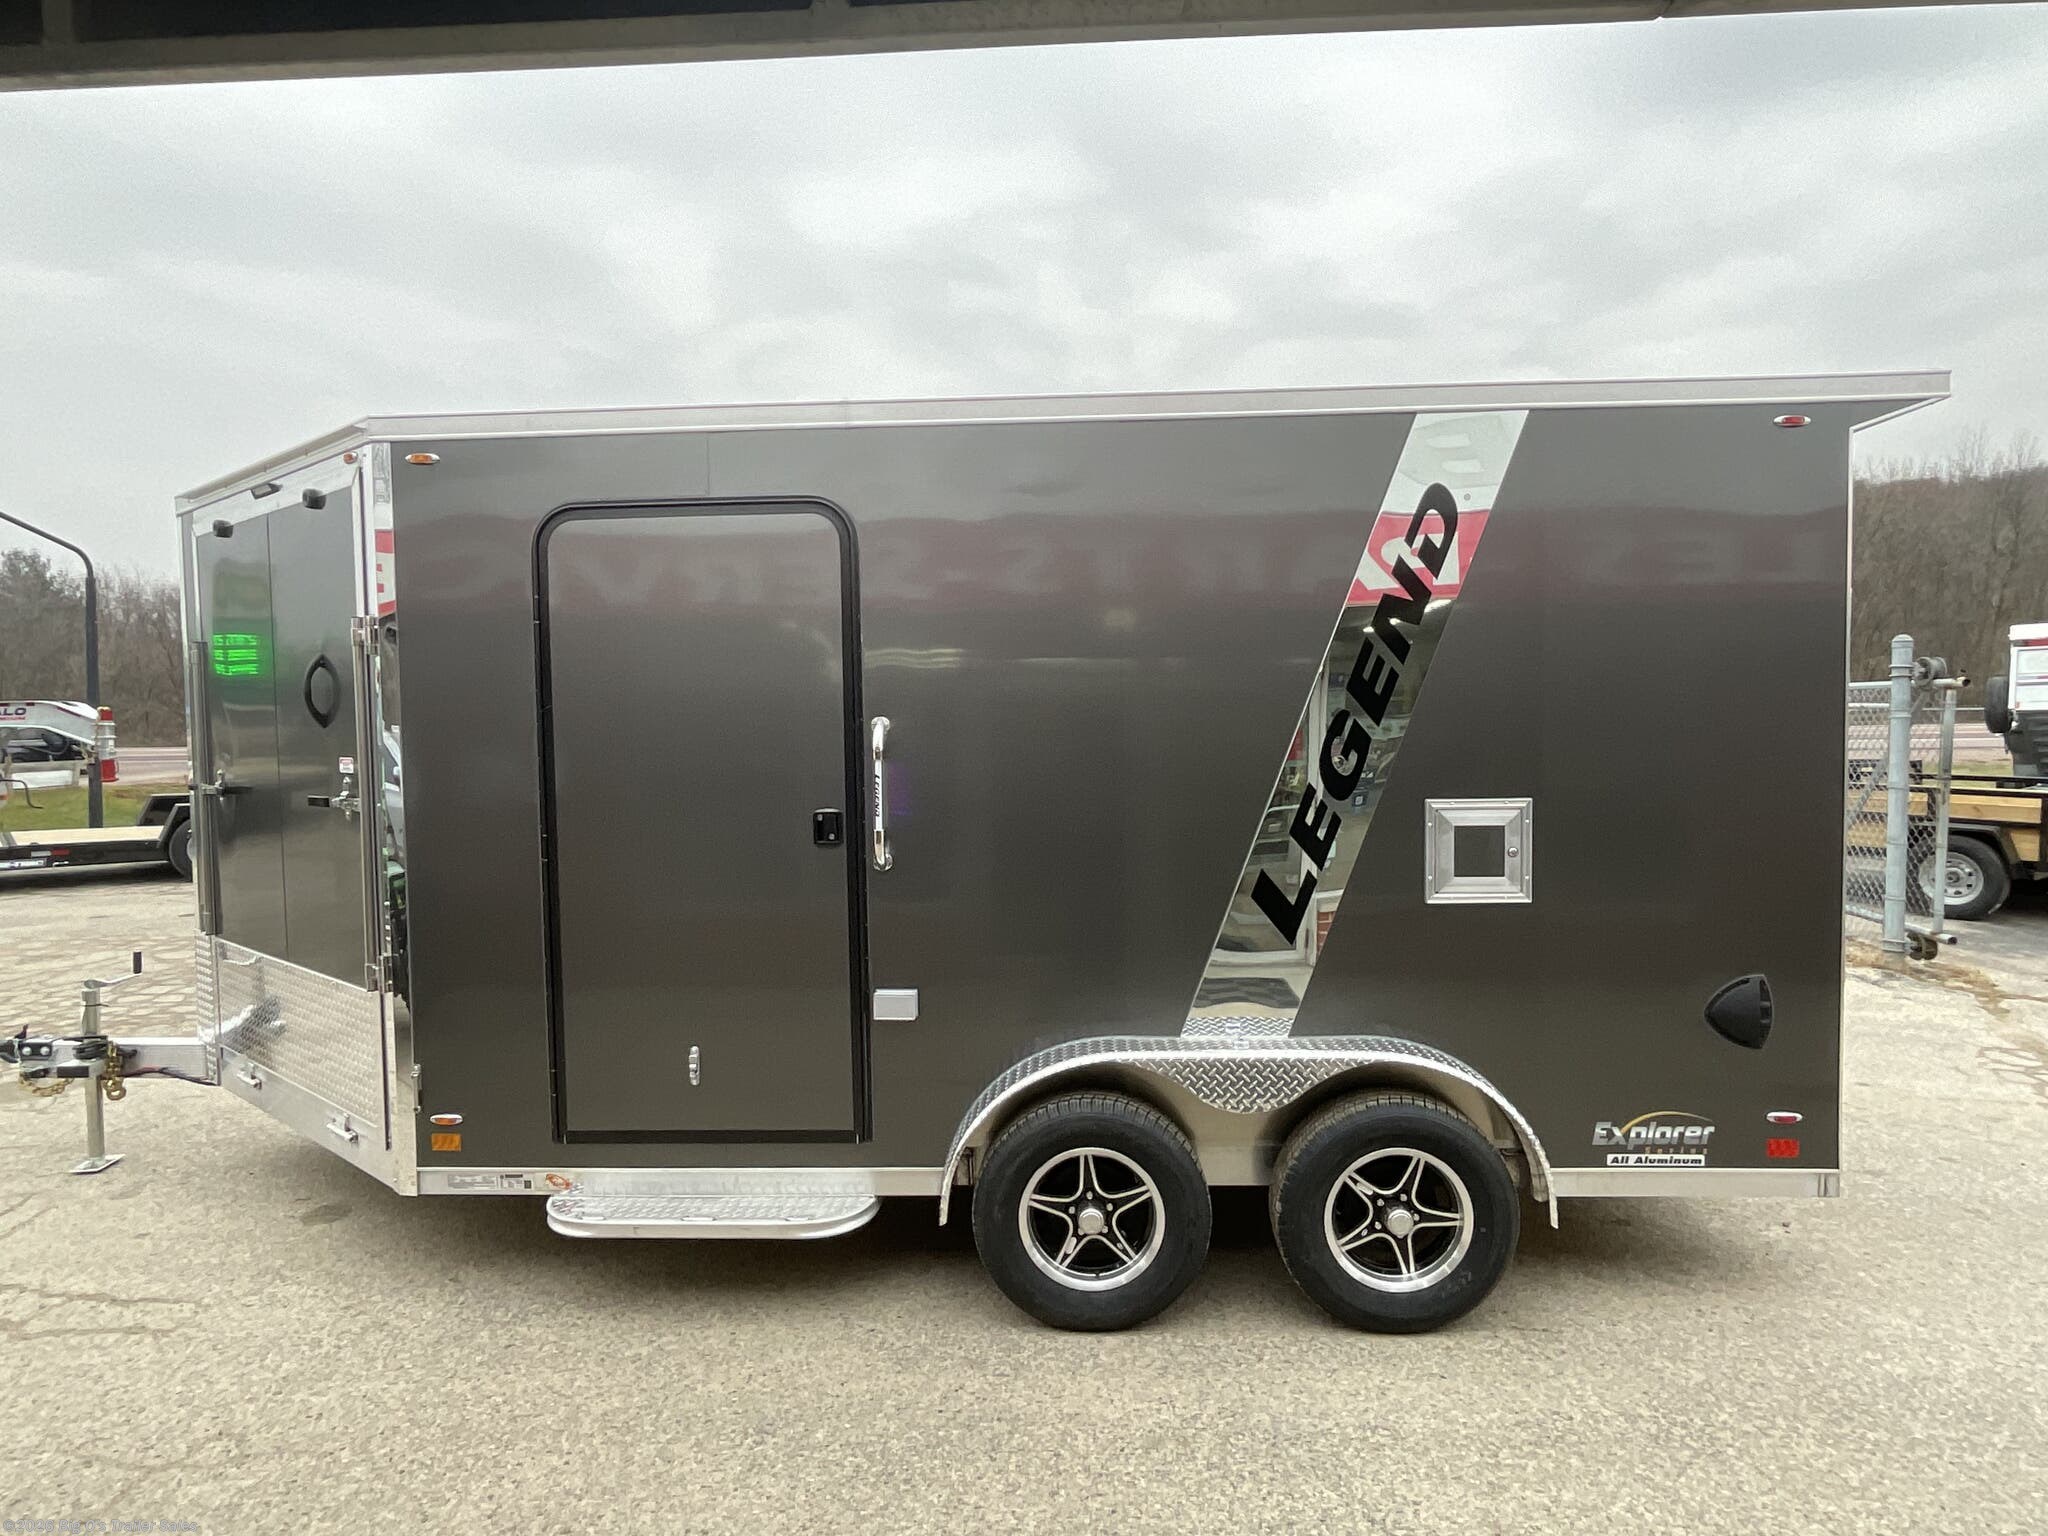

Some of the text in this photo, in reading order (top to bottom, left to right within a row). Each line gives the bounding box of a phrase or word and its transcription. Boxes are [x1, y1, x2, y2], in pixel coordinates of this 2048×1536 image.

[1251, 481, 1458, 945] LEGEND
[873, 774, 881, 817] LEGEND
[1592, 1121, 1716, 1150] Explorer
[1610, 1155, 1703, 1165] All Aluminum
